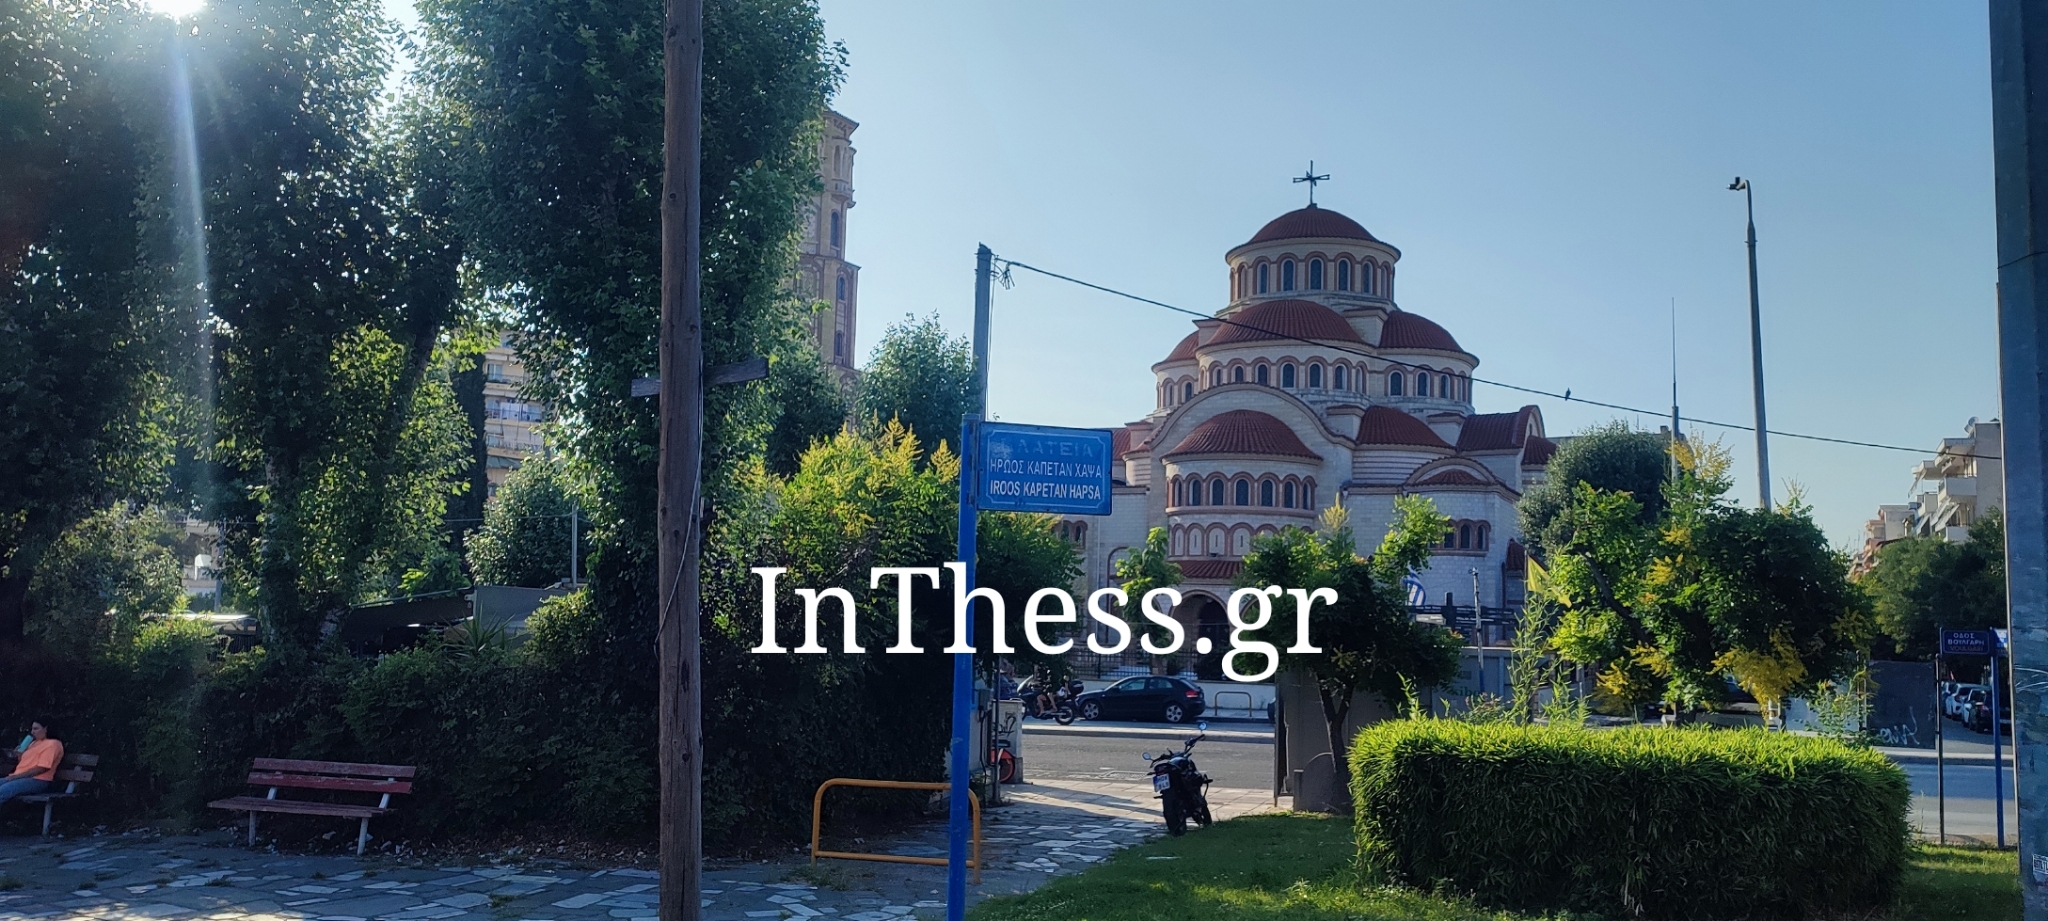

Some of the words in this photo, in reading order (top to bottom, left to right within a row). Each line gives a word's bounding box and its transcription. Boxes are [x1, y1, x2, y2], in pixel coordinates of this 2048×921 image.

[990, 458, 1024, 474] ΗΡΩΟΣ
[1027, 460, 1072, 477] ΚΑΠΕΤΑΝ
[1074, 463, 1102, 478] ΧΑΨΑ
[990, 480, 1020, 496] IROOS
[1023, 481, 1067, 499] KAPETAN
[1069, 484, 1101, 500] HAPSA
